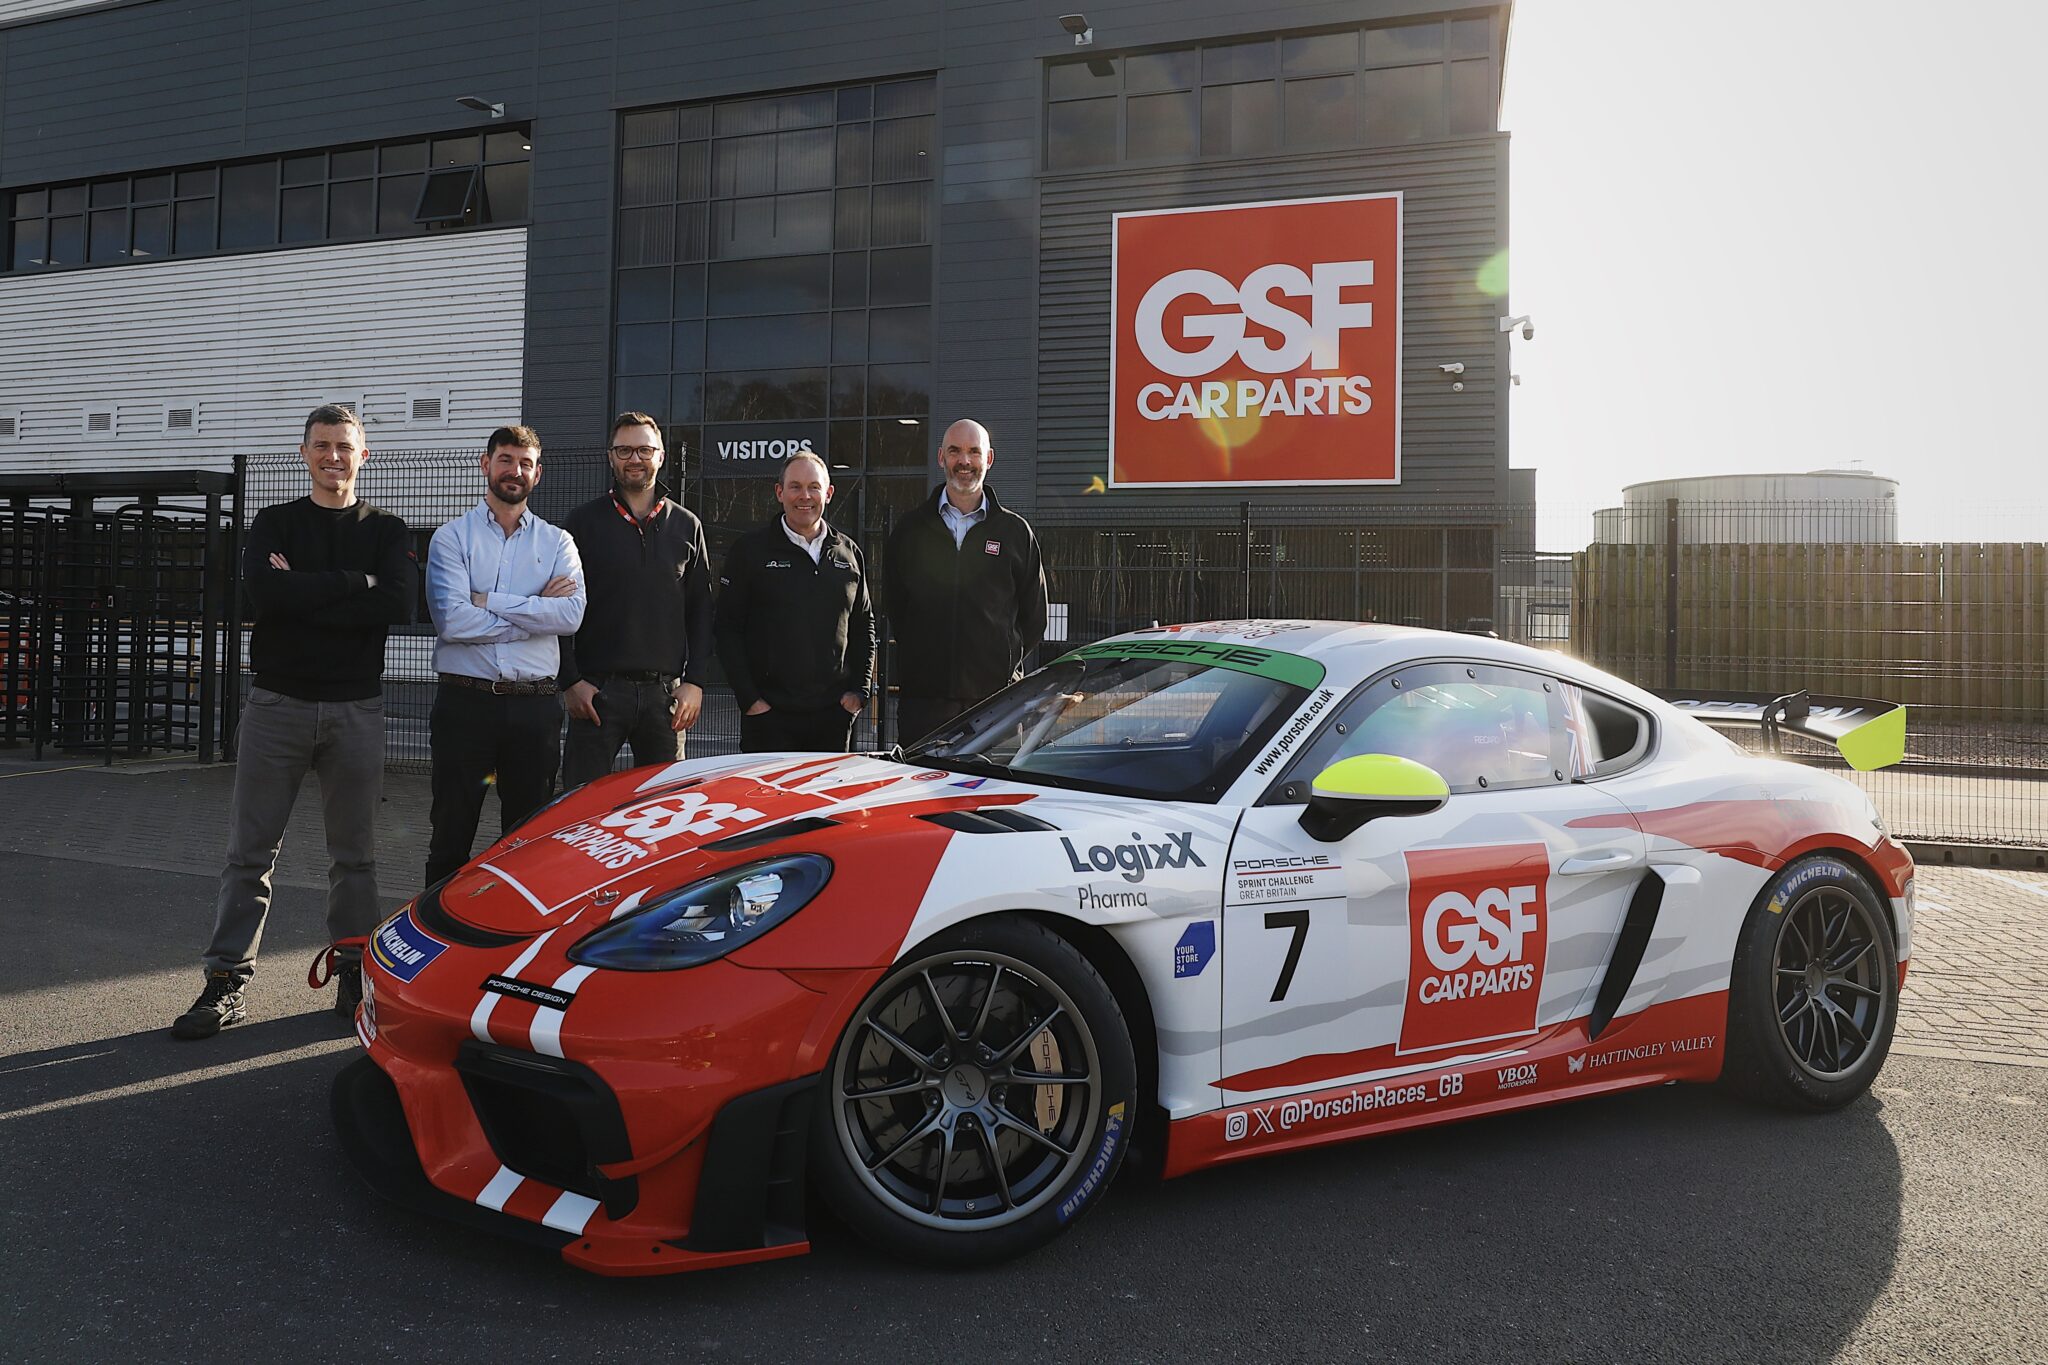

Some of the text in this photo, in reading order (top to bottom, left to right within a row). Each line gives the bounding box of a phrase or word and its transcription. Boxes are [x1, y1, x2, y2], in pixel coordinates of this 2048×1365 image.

[1135, 260, 1374, 377] GSF
[1136, 375, 1371, 420] CAR PARTS
[717, 439, 812, 459] VISITORS
[1254, 688, 1335, 776] www.porsche.co.uk
[601, 792, 767, 844] GSF
[551, 823, 648, 869] CAR PARTS
[1060, 832, 1206, 883] LogixX
[1234, 855, 1329, 869] PORSCHE
[1238, 875, 1314, 889] SPRINT CHALLENGE
[1240, 887, 1297, 900] GREAT BRITAIN
[1787, 866, 1841, 895] MICHELIN
[1078, 884, 1148, 910] Pharma
[1422, 885, 1537, 971] GSF
[382, 926, 426, 966] MICHELIN
[1176, 945, 1195, 956] YOUR
[1176, 954, 1199, 964] STORE
[1264, 910, 1310, 1002] 7
[1176, 964, 1185, 973] 24
[1419, 963, 1534, 1004] CAR PARTS
[487, 979, 568, 1004] PORSCHE DESIGN
[1589, 1036, 1715, 1068] HATTINGLEY VALLEY
[1497, 1063, 1538, 1084] VBOX
[1497, 1077, 1537, 1090] MOTORSPORT
[1280, 1072, 1464, 1130] @PorscheRaces_GB
[1062, 1135, 1115, 1217] MICHELIN
